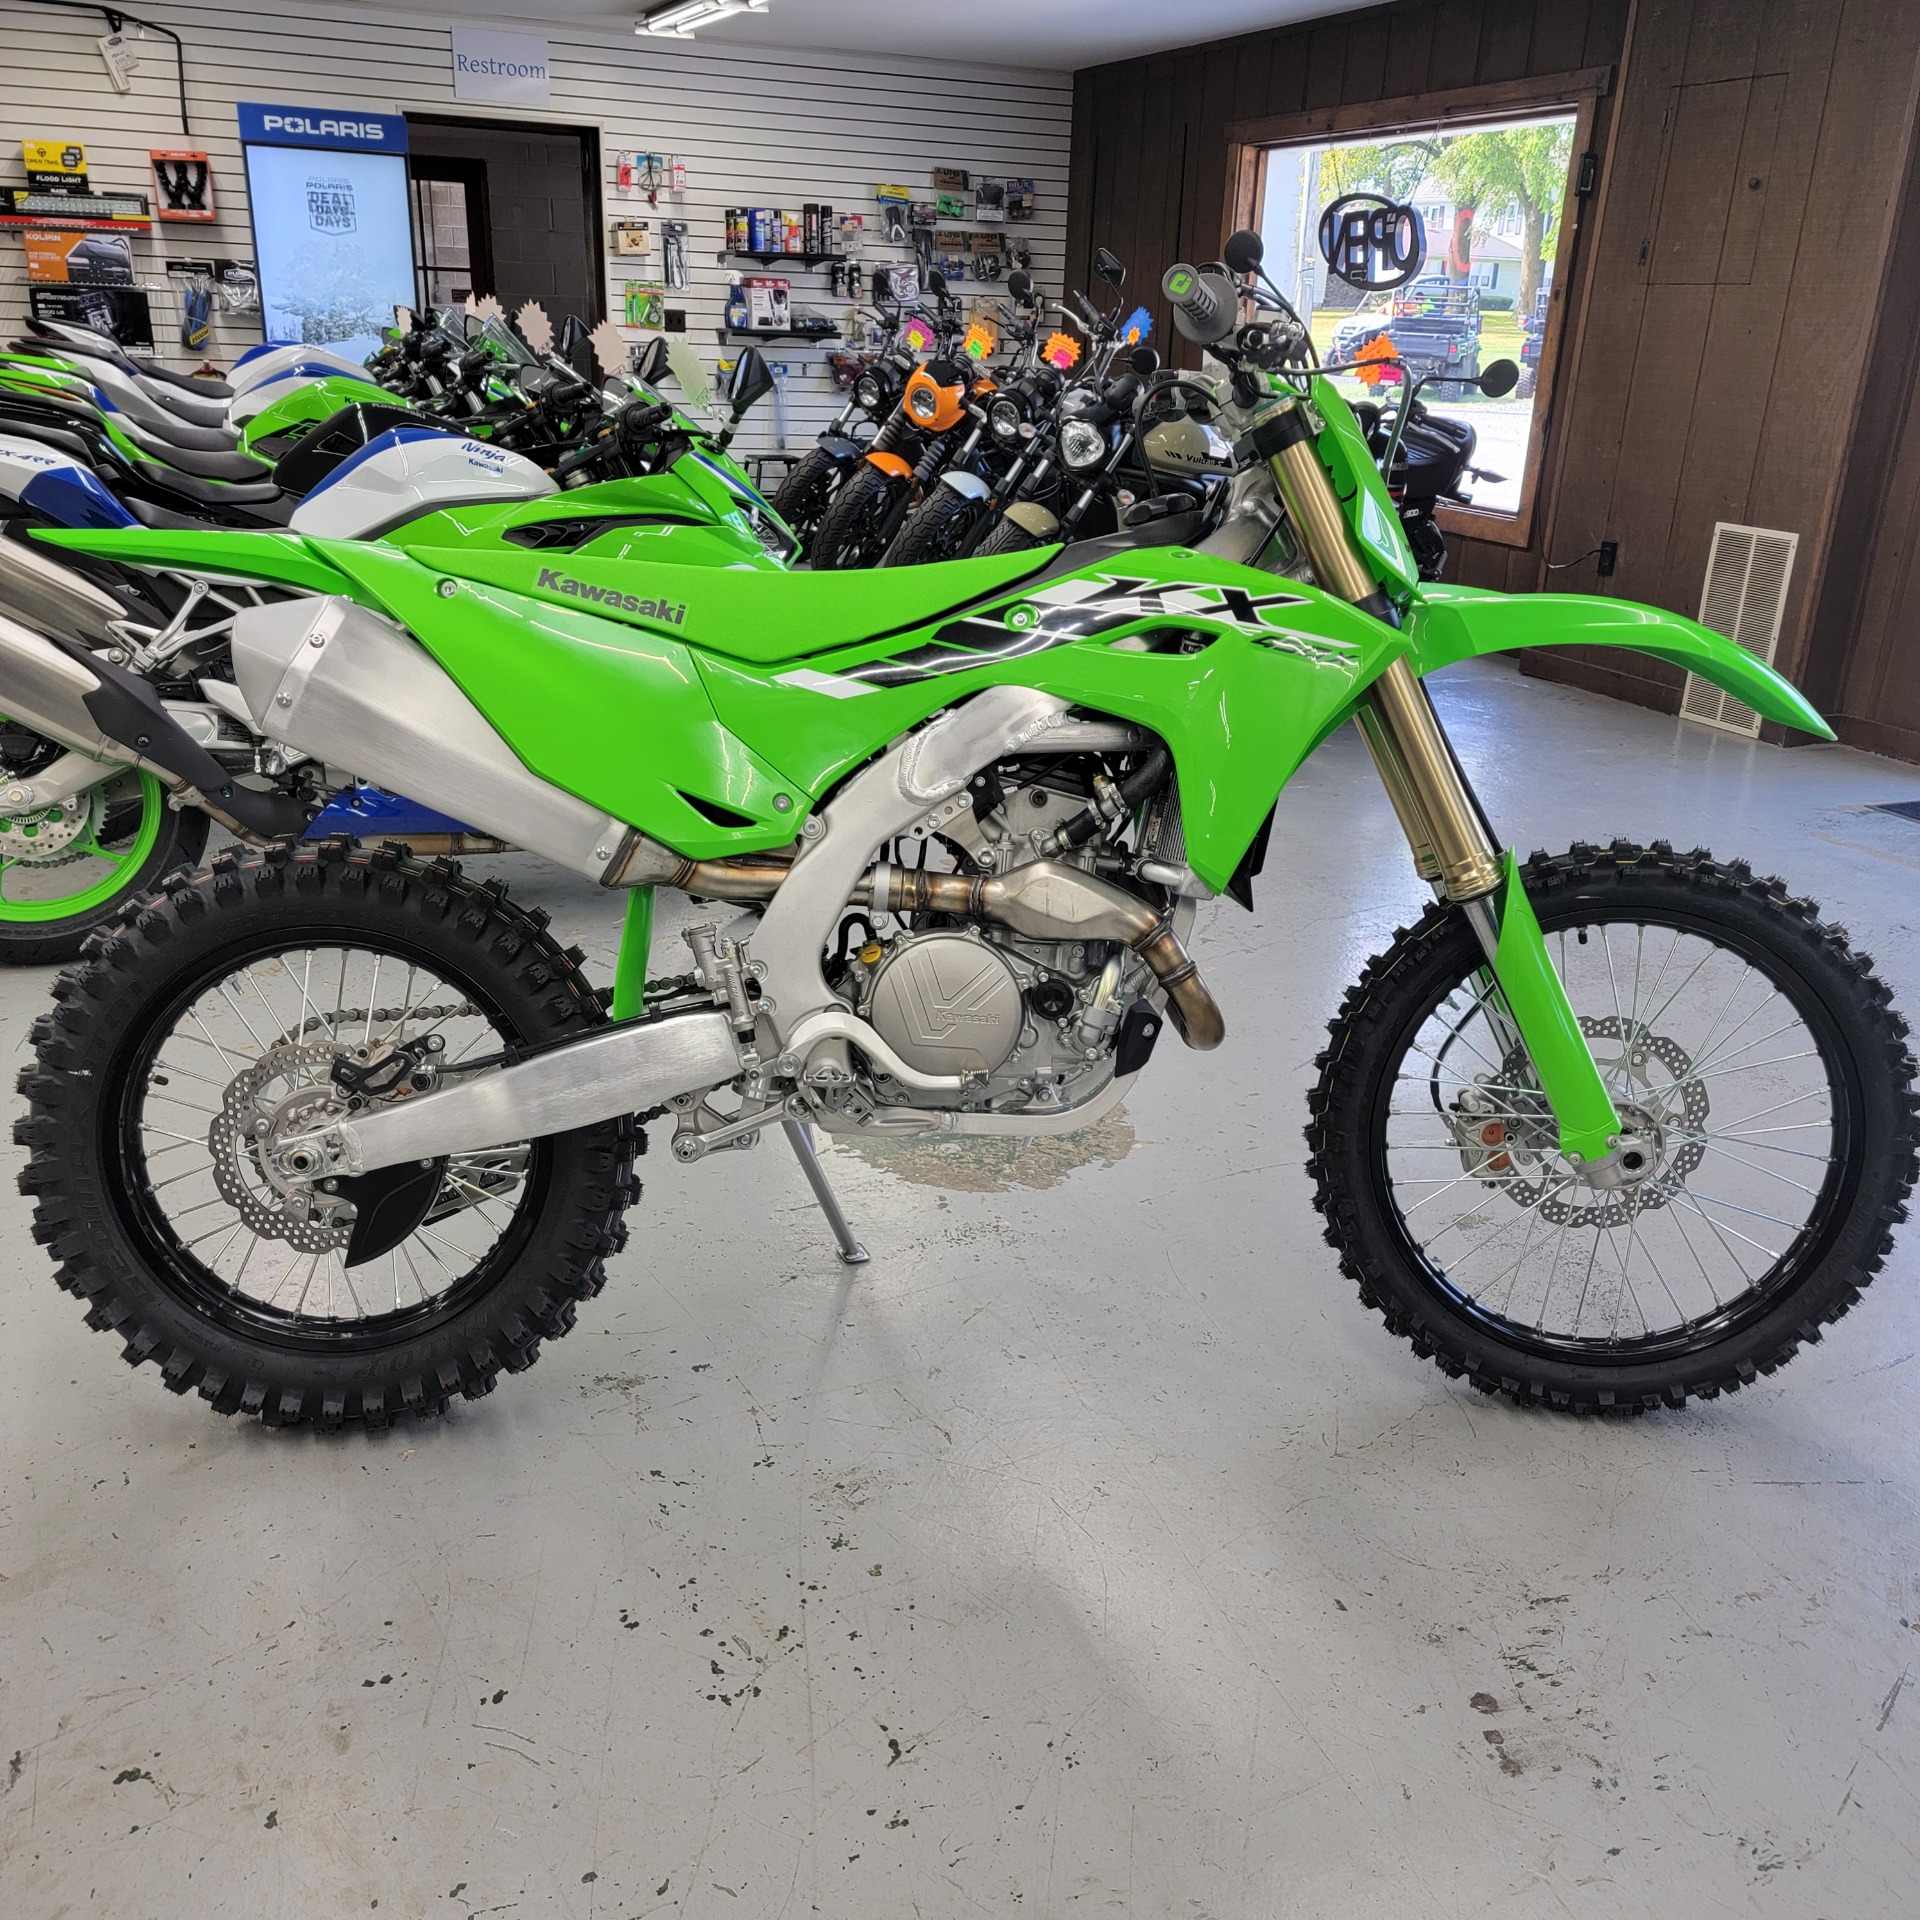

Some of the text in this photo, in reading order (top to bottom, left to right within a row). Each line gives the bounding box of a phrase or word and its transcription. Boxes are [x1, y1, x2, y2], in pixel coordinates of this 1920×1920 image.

[456, 54, 547, 79] Restroom
[263, 115, 384, 139] POLARIS
[36, 174, 82, 184] FLOOD LIGHT
[306, 182, 353, 191] POLARIS
[309, 191, 351, 206] DEAL
[315, 215, 351, 228] DAYS
[25, 232, 61, 241] KOLPIN
[371, 402, 427, 419] Kawasaki
[0, 449, 56, 465] X-4RR
[461, 441, 506, 462] Ninja
[468, 457, 504, 474] Kawasaki
[1186, 454, 1215, 467] Vulcan
[536, 567, 687, 625] Kawasaki
[1085, 573, 1314, 627] KX
[936, 1009, 1000, 1025] Kawasaki
